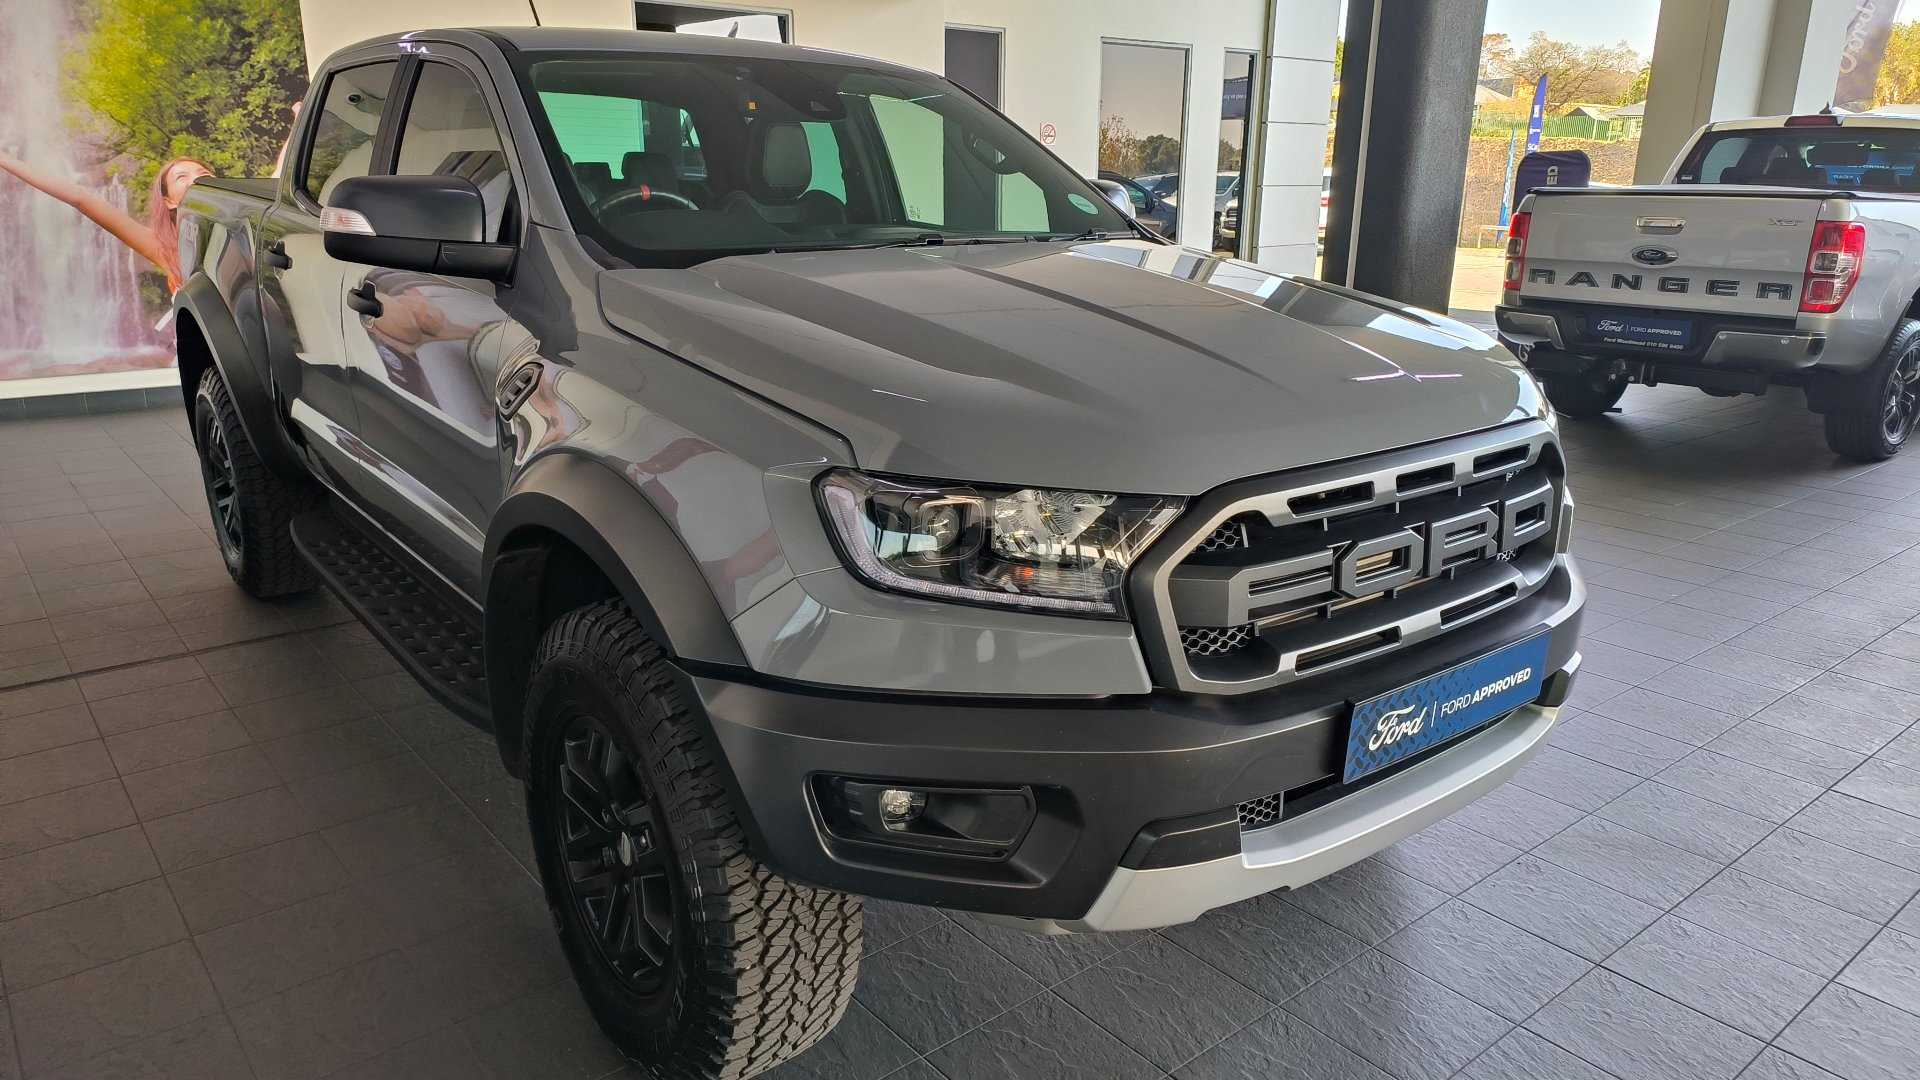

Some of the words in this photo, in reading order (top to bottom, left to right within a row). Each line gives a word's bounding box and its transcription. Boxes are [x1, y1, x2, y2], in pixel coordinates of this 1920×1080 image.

[1528, 268, 1793, 300] RANGER
[1597, 319, 1624, 333] Ford
[1647, 328, 1682, 336] APPROVED
[1228, 483, 1553, 628] FORD
[1368, 704, 1428, 751] Ford
[1440, 693, 1472, 718] FORD
[1470, 667, 1532, 705] APPROVED
